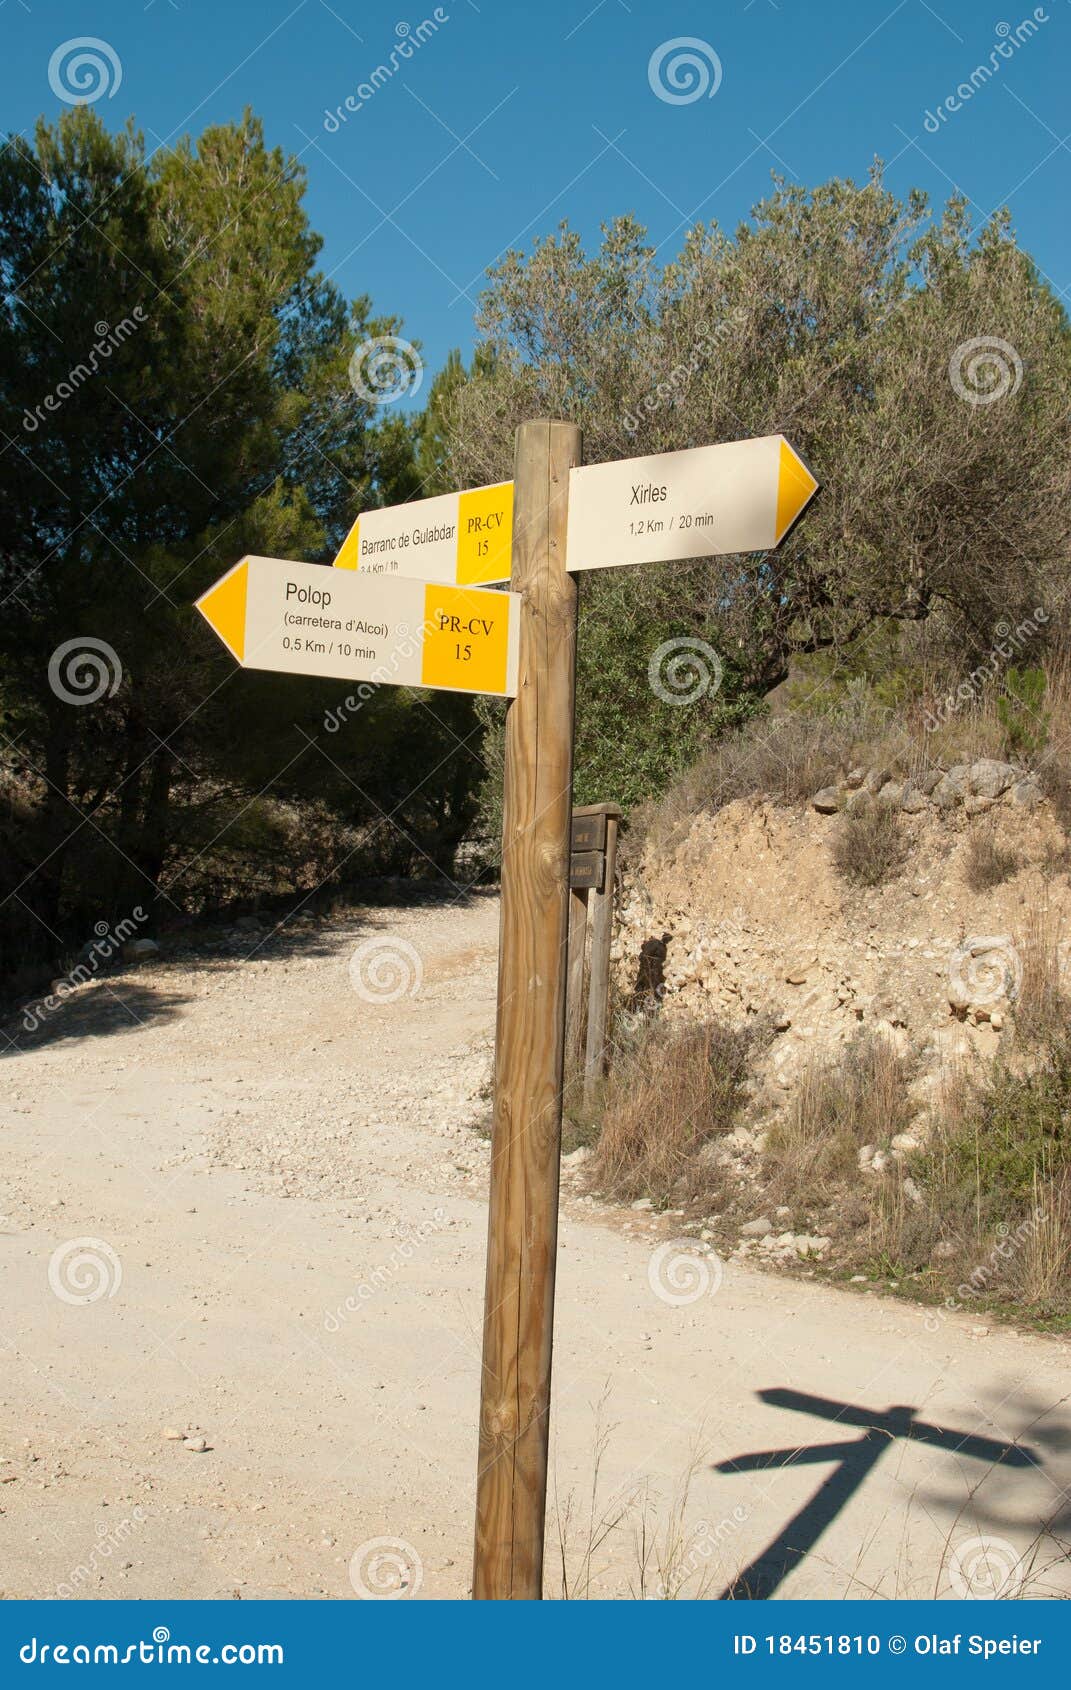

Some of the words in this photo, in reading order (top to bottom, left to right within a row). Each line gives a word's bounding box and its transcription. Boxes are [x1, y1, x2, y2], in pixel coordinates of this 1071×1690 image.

[630, 483, 667, 505] Xirles
[467, 512, 504, 533] PR-CV
[629, 521, 644, 536] 1,2
[647, 519, 663, 533] Km
[679, 515, 692, 528] 20
[695, 512, 713, 527] min
[361, 535, 397, 555] Barranc
[398, 535, 410, 548] de
[412, 524, 456, 545] Gulabdar
[477, 540, 489, 557] 15
[372, 563, 384, 574] Km
[285, 582, 332, 609] Polop
[284, 611, 342, 631] (carretera
[439, 614, 494, 636] PR-CV
[282, 637, 302, 651] 0,5
[305, 640, 326, 653] Km
[337, 644, 351, 656] 10
[355, 646, 376, 660] min
[455, 643, 472, 661] 15
